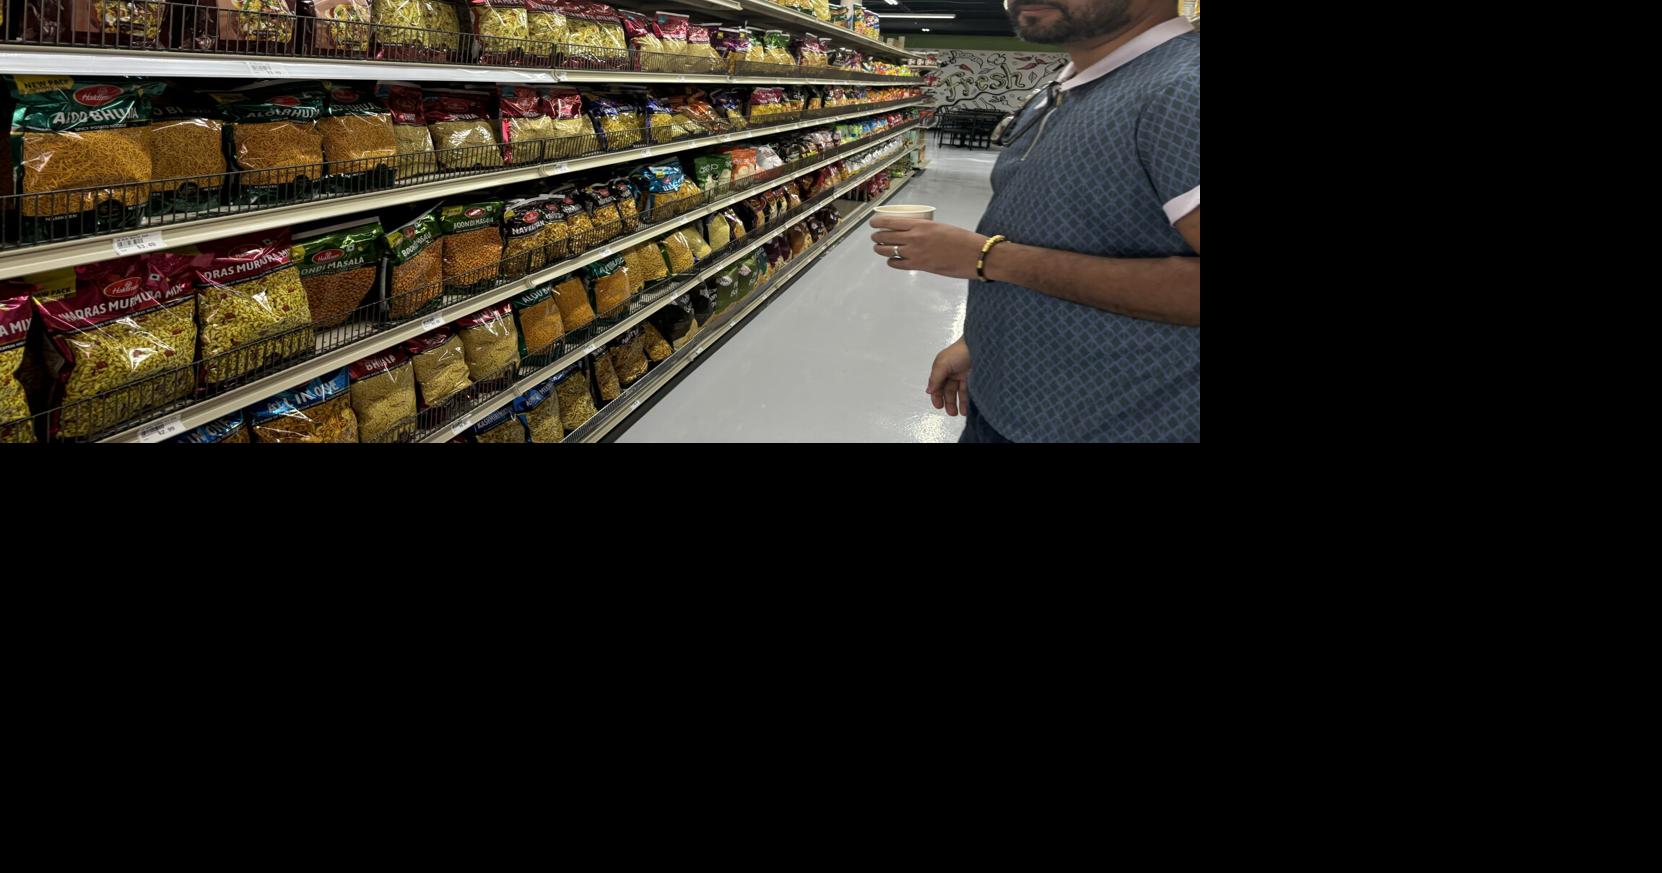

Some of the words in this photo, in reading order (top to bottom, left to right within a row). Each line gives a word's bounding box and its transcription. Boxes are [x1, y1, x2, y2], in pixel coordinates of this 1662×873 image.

[24, 80, 47, 89] NEW
[327, 256, 365, 269] MASALA
[165, 284, 183, 299] MIX
[10, 316, 32, 334] MIX
[296, 391, 314, 404] IN
